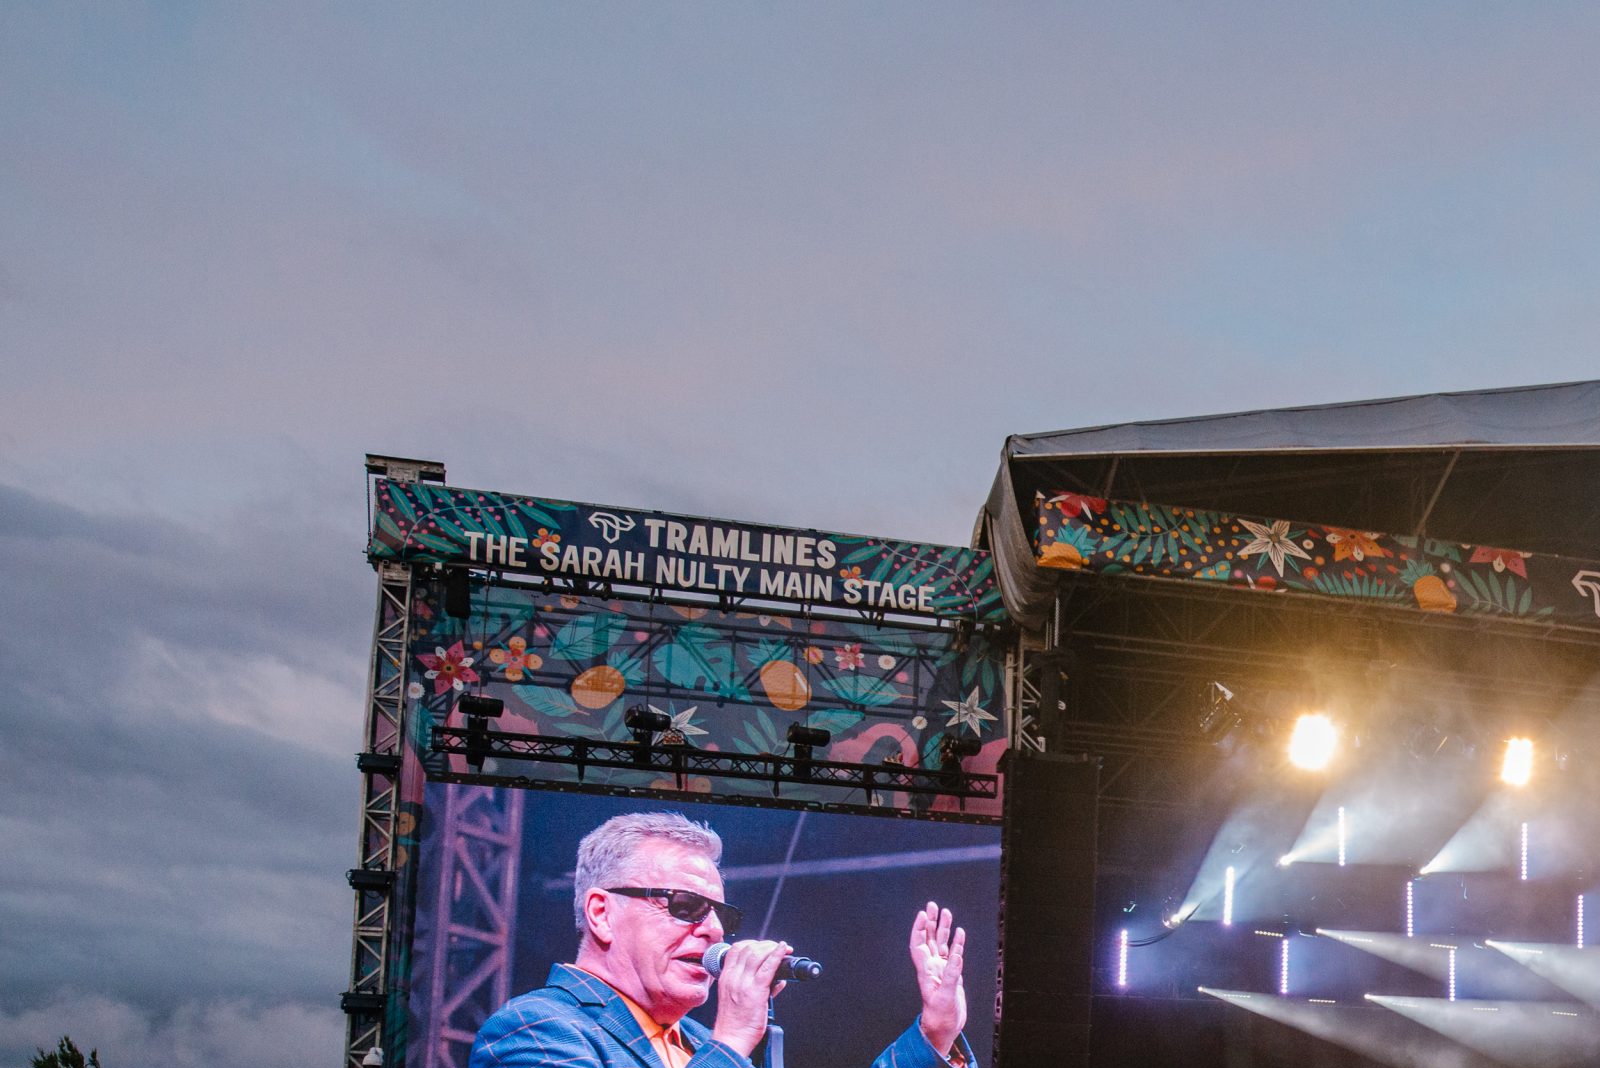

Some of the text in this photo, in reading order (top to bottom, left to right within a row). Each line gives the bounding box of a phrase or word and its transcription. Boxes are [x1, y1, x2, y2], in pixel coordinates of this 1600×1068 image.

[464, 531, 936, 612] THE SARAH NULTY MAIN STAGE
[645, 519, 837, 569] TRAMLINES
